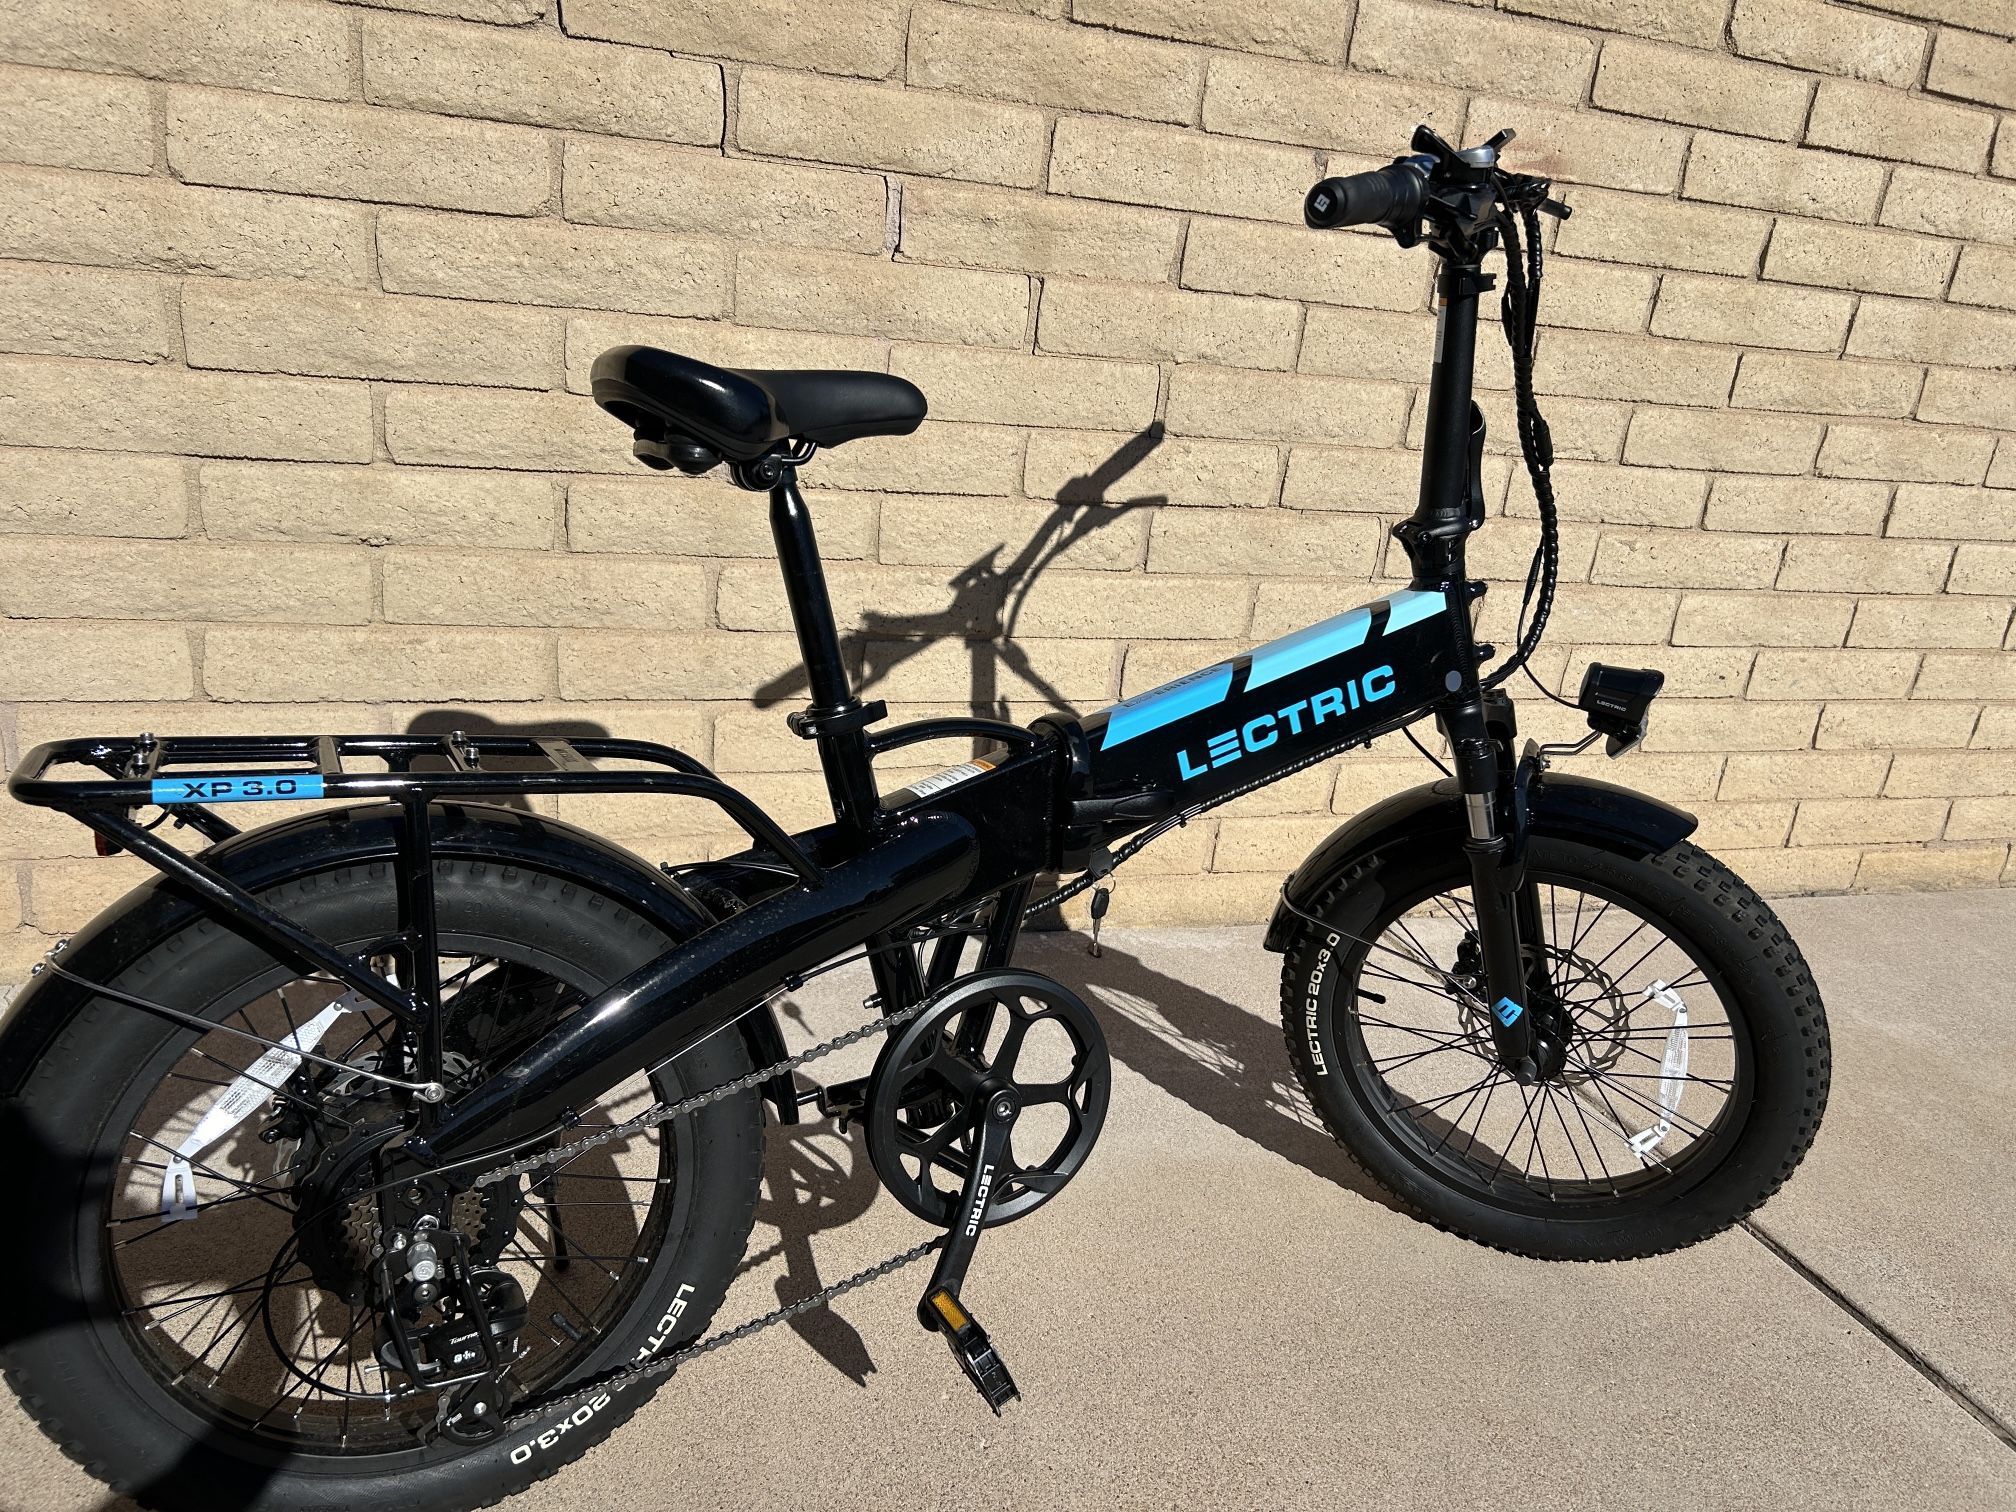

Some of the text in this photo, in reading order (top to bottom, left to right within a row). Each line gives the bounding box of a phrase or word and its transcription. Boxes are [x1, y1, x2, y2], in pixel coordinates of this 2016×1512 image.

[1176, 665, 1396, 781] LECTRIC
[182, 779, 297, 799] XP 3.0
[1305, 932, 1341, 1077] LECTRIC 20x3.0
[965, 1164, 995, 1237] LECTRIC
[510, 1283, 695, 1465] LECTR 20x3.0
